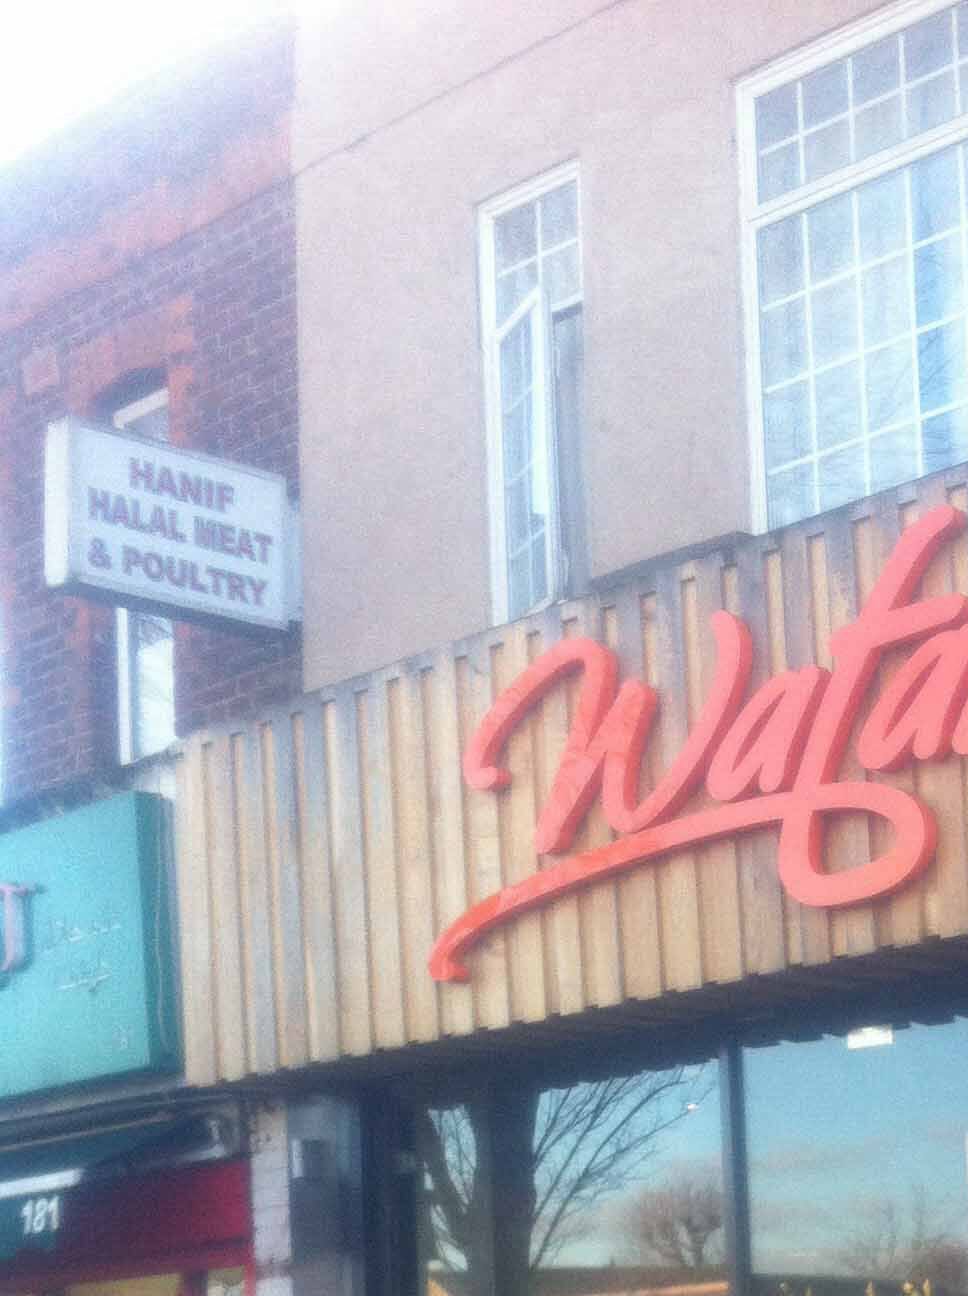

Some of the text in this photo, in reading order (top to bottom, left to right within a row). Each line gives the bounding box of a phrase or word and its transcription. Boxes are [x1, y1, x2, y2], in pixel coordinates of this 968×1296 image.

[128, 457, 235, 513] HANIF
[87, 486, 274, 565] HALAL MEAT
[87, 537, 269, 606] & POULTRY
[21, 1196, 60, 1235] 181
